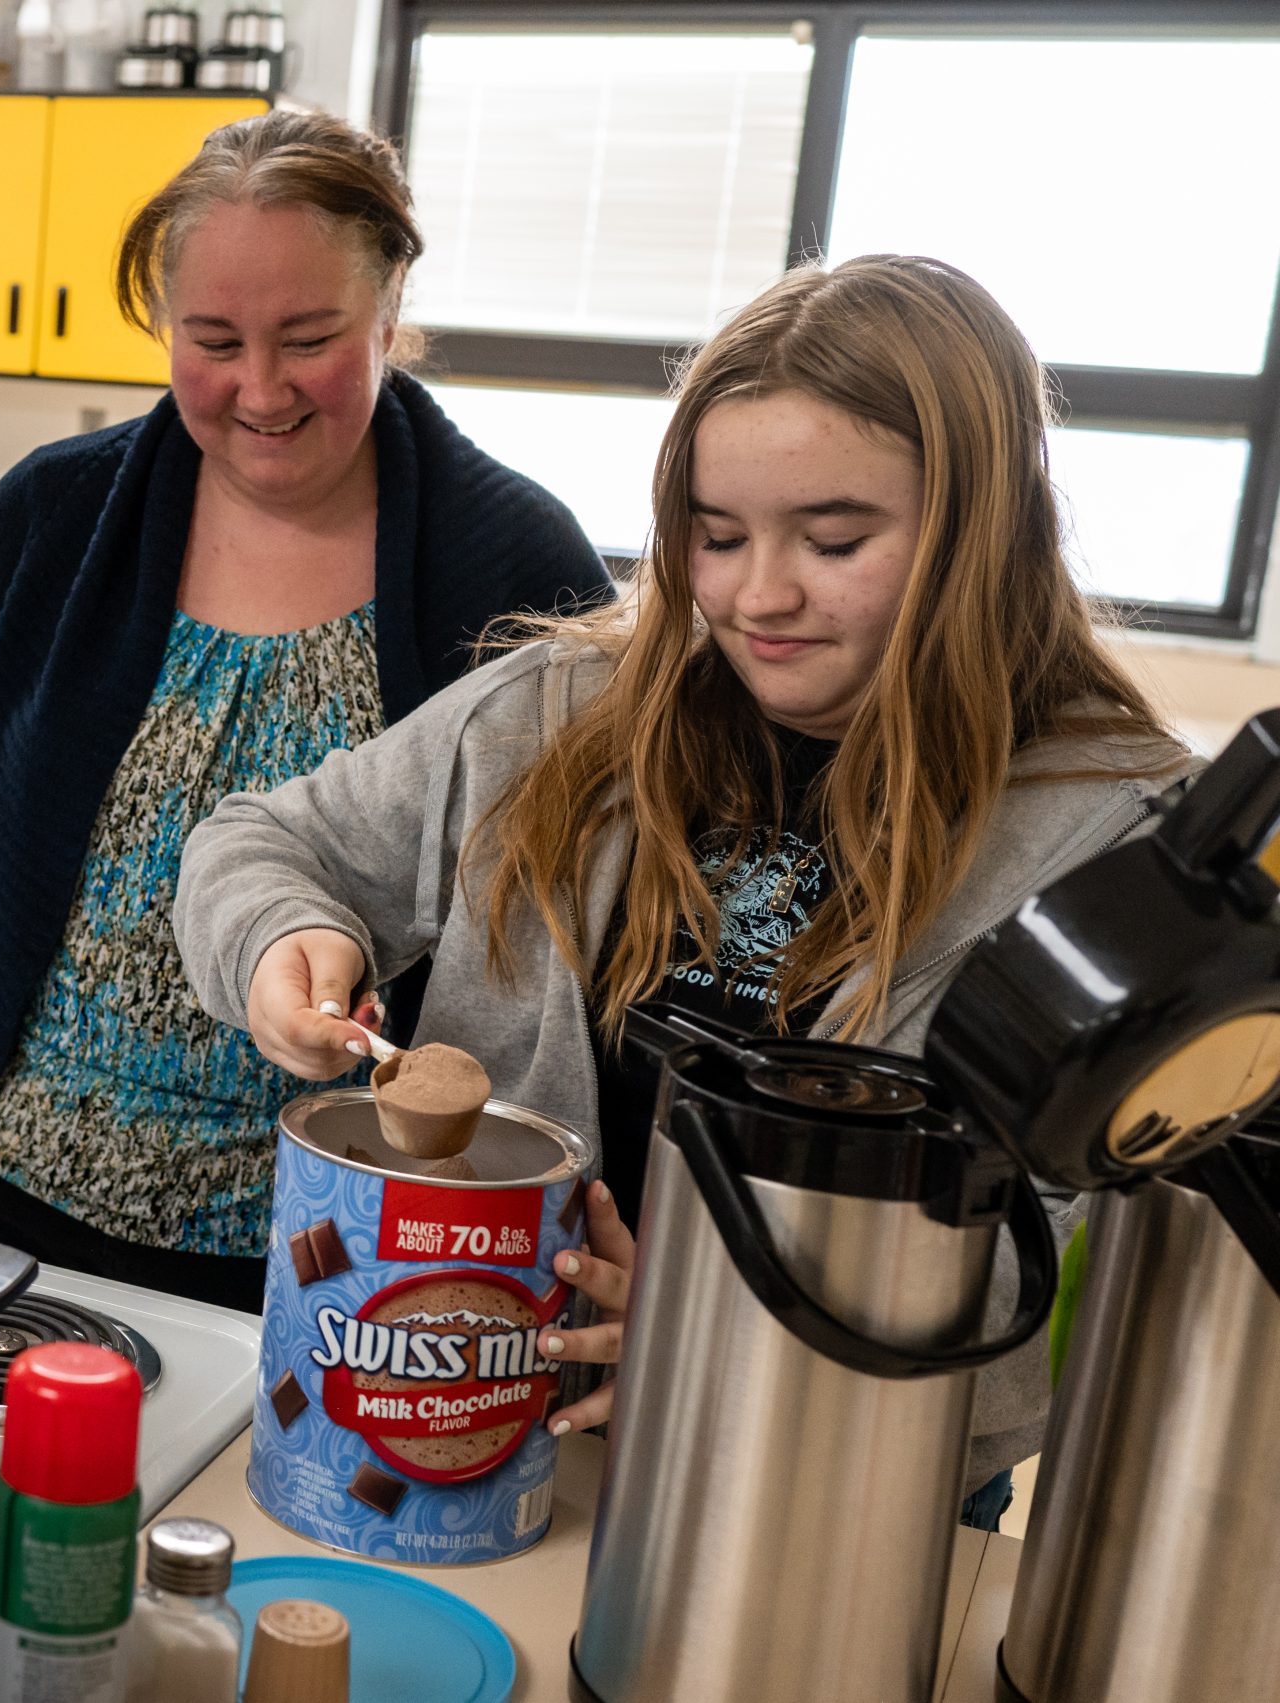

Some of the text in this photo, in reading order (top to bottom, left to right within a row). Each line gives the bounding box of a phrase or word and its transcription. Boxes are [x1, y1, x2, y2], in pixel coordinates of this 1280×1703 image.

[397, 1218, 445, 1239] MAKES
[499, 1226, 510, 1241] 8
[396, 1233, 444, 1254] ABOUT
[449, 1225, 491, 1256] 70
[493, 1238, 531, 1256] MUGS
[310, 1306, 469, 1379] SWISS
[357, 1383, 532, 1420] Milk Chocolate
[429, 1416, 471, 1433] FLAVOR
[395, 1532, 411, 1548] NET
